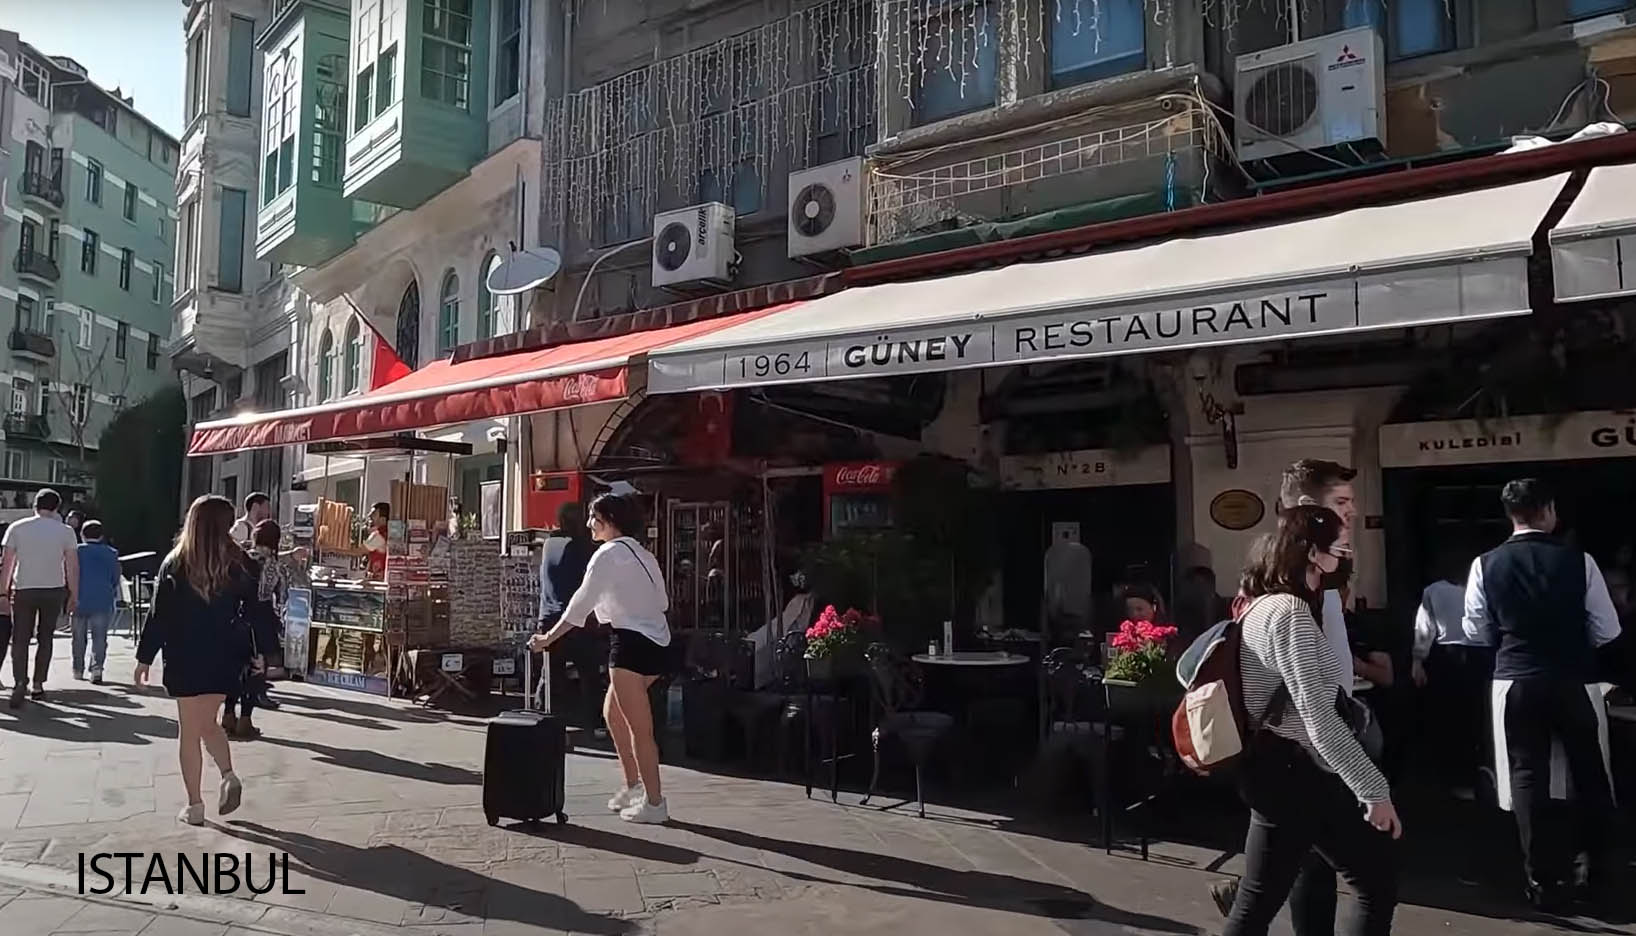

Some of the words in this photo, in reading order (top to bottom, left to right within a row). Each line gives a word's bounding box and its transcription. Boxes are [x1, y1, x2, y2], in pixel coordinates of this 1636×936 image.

[739, 351, 811, 378] 1964
[844, 335, 972, 369] GÜNEY
[1015, 293, 1328, 353] RESTAURANT
[836, 465, 881, 485] Coca-Cola
